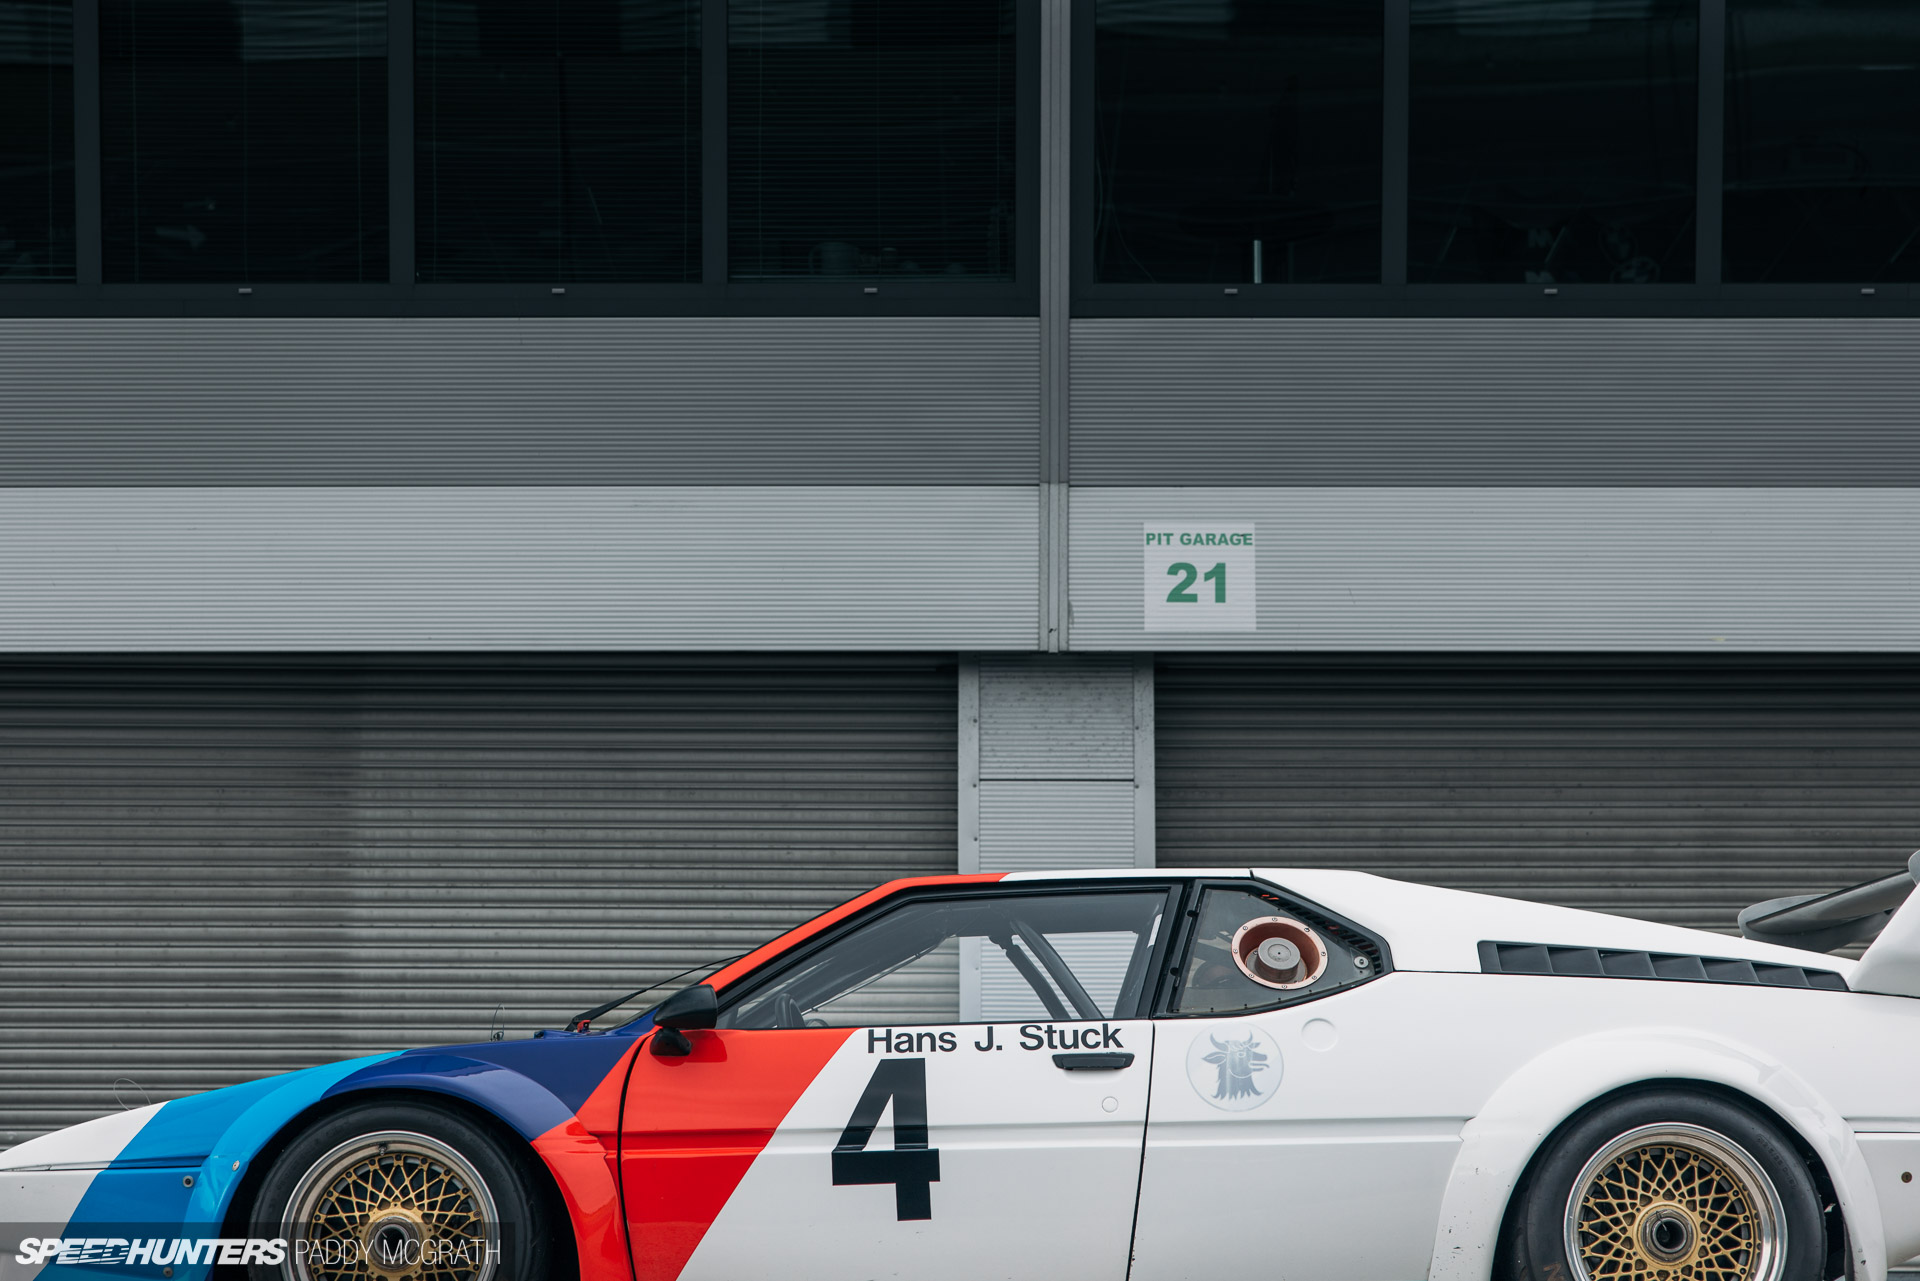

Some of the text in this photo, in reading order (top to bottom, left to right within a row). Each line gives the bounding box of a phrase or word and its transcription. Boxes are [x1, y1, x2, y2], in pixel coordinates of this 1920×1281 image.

[1145, 533, 1253, 546] PIT GARAGE
[1166, 562, 1226, 603] 21
[867, 1023, 1124, 1053] Hans J. Stuck
[832, 1058, 940, 1221] 4
